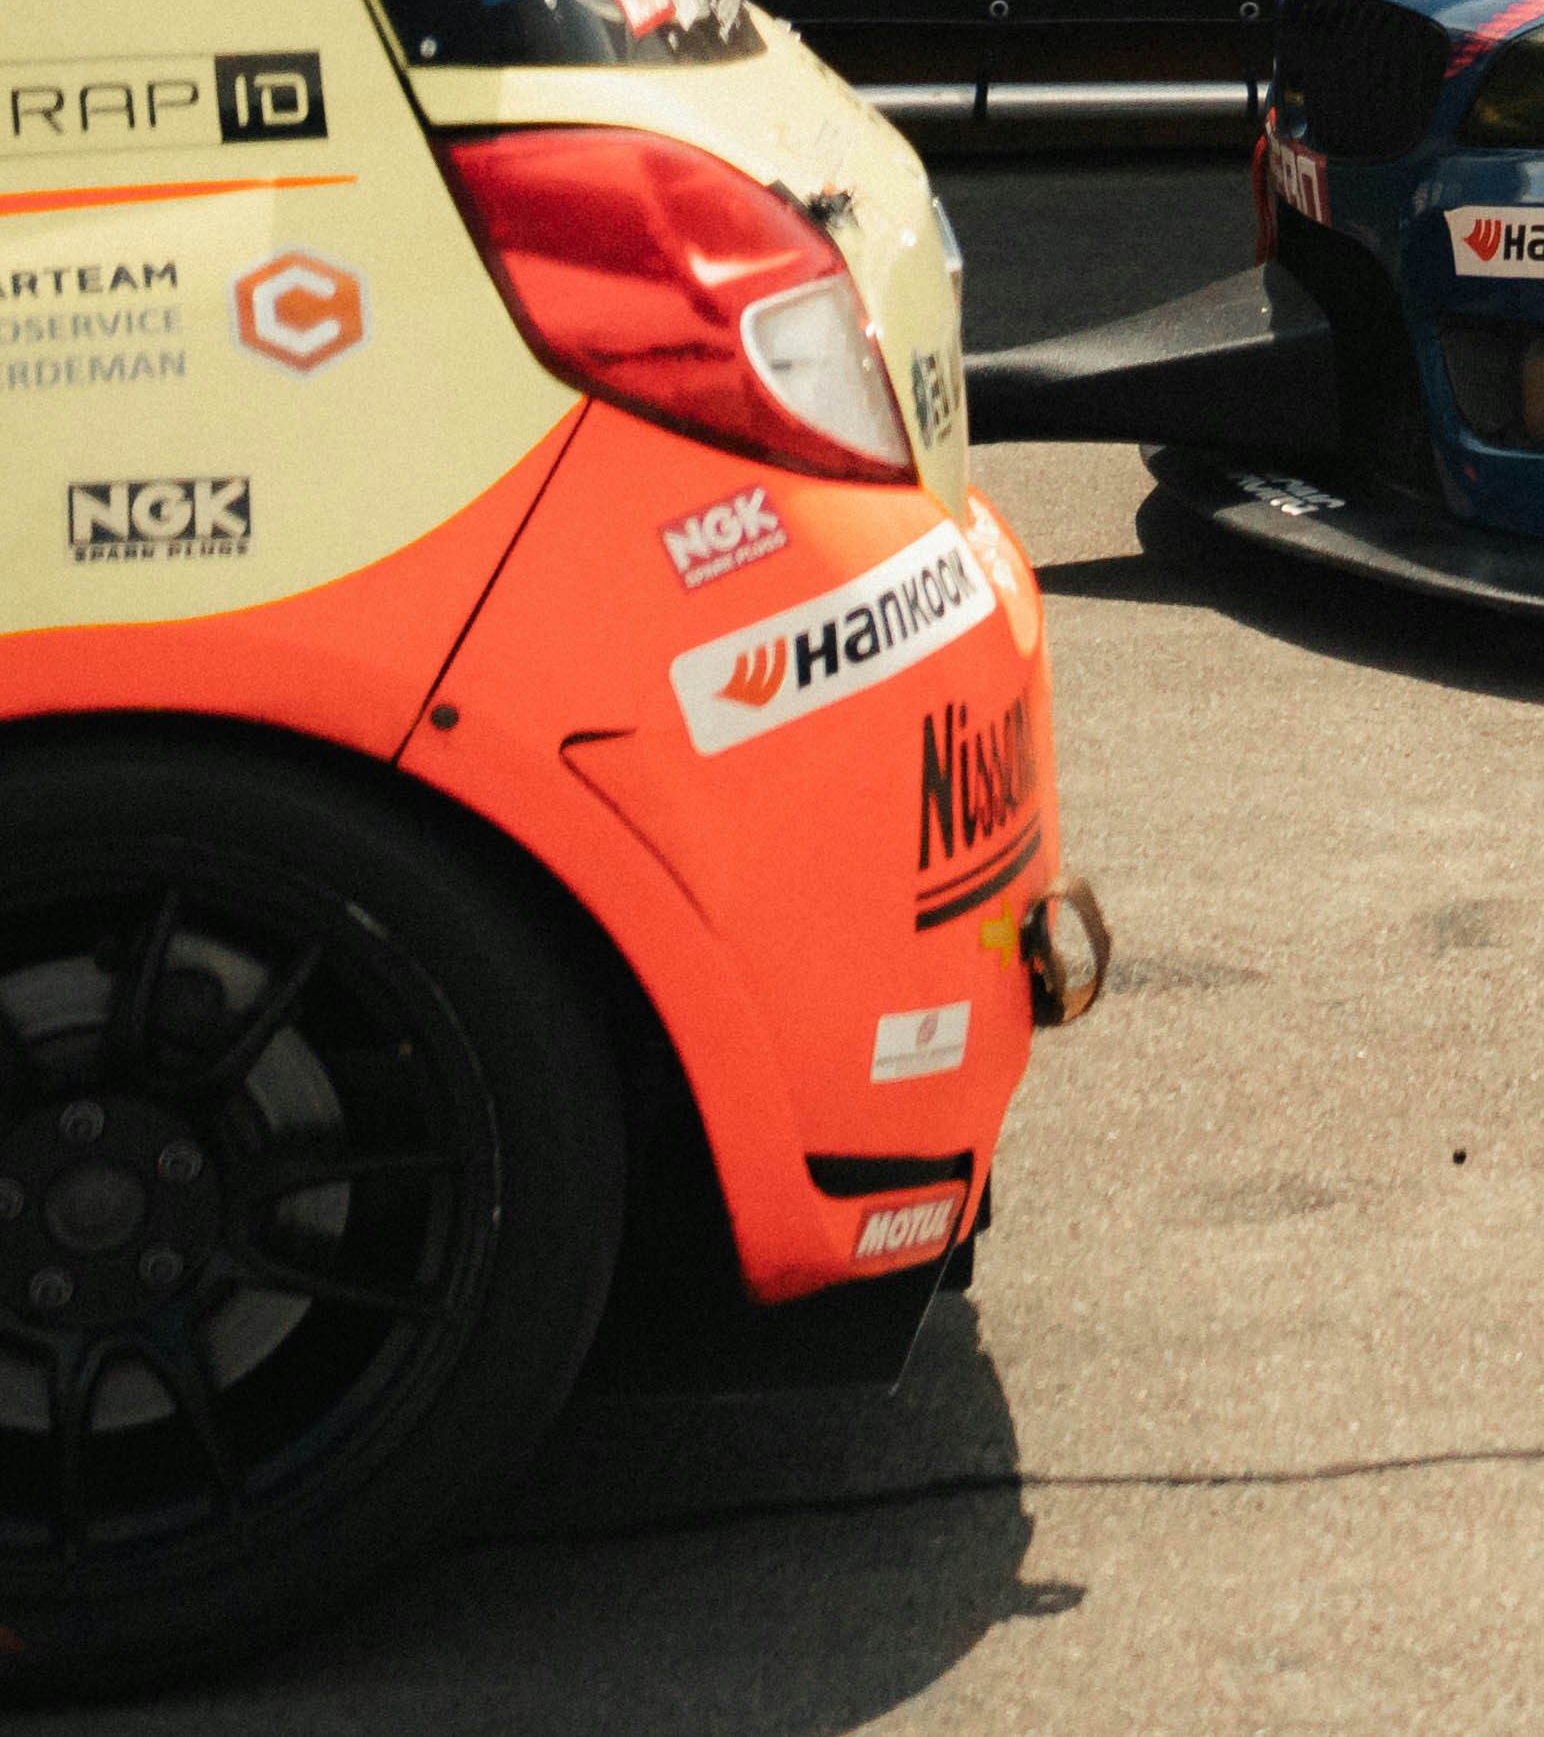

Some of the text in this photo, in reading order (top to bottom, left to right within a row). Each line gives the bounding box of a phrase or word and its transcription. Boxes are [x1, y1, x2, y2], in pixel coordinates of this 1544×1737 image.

[0, 350, 188, 393] RDEMAN
[72, 478, 249, 543] NGK
[662, 486, 779, 574] NGK
[855, 1197, 957, 1260] MOTUL
